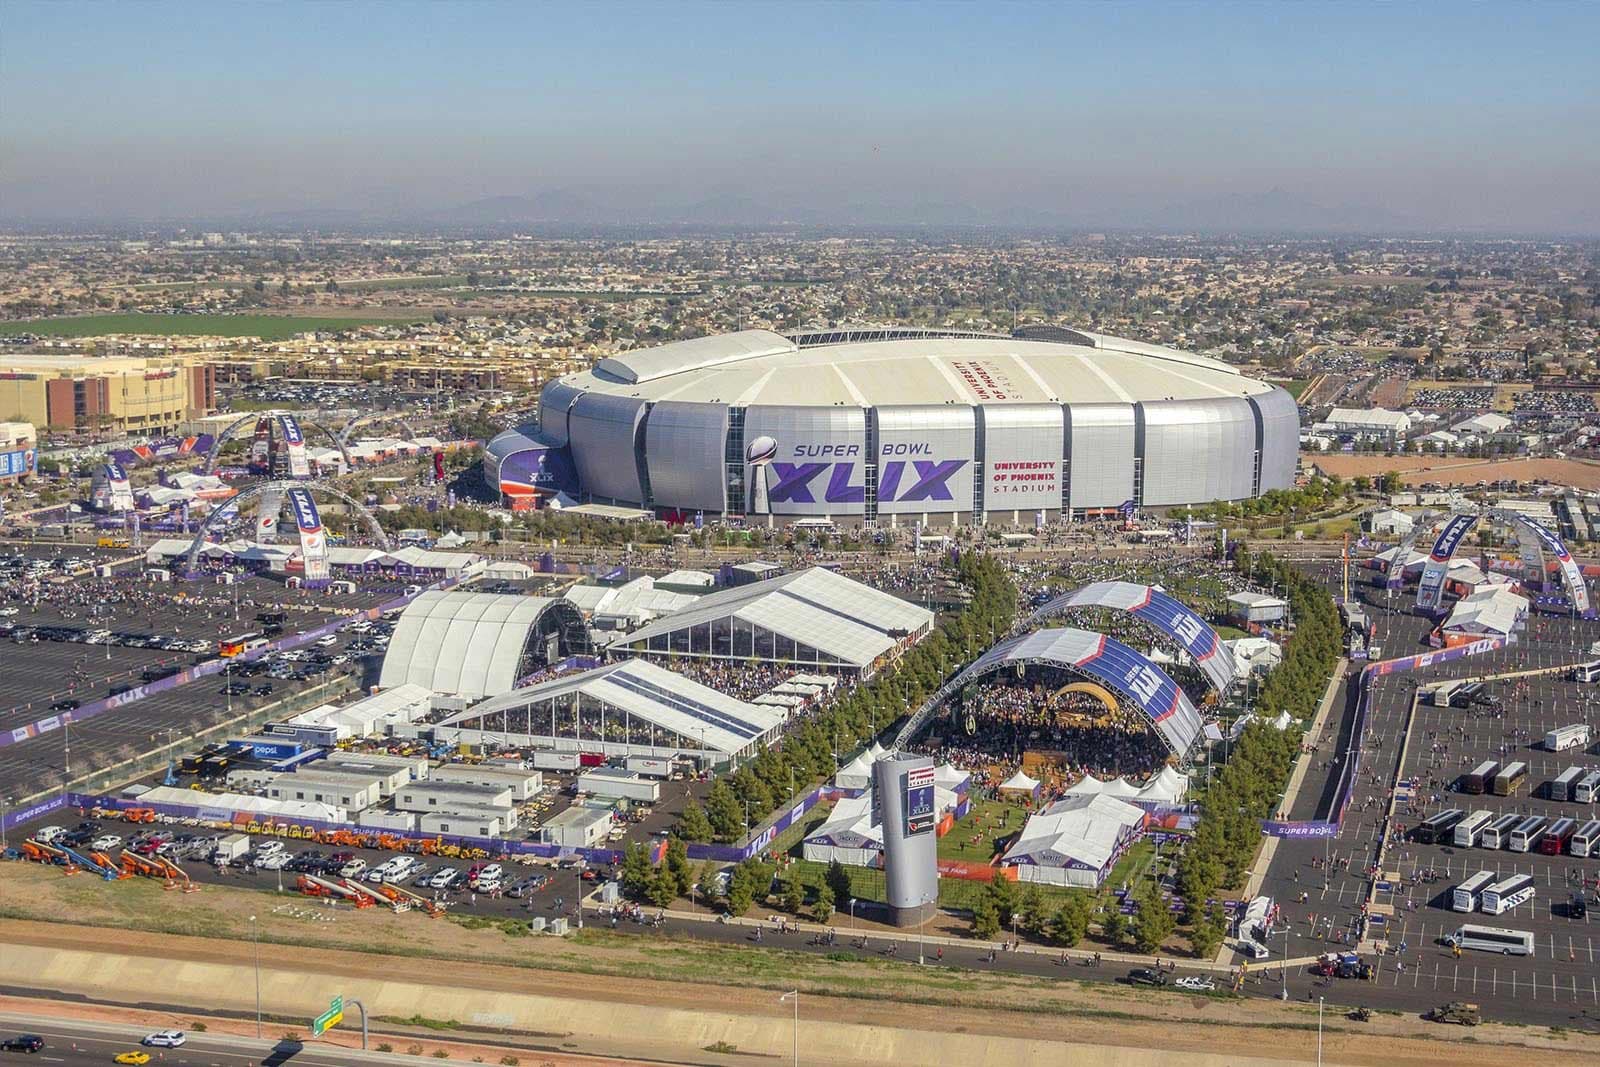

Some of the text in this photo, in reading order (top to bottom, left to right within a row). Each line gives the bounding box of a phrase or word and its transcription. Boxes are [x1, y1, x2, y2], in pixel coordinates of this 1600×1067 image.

[951, 361, 990, 400] UNIVERSITY
[967, 361, 1006, 400] OF PHOENIX
[793, 443, 933, 457] SUPER BOWL
[994, 462, 1056, 470] UNIVERSITY
[529, 472, 555, 482] XLIX
[768, 460, 970, 503] XLIX
[993, 473, 1055, 482] OF PHOENIX
[993, 484, 1055, 493] STADIUM
[254, 746, 278, 754] pepsi
[912, 807, 930, 816] XLIX
[1278, 827, 1333, 835] SUPER BOWL
